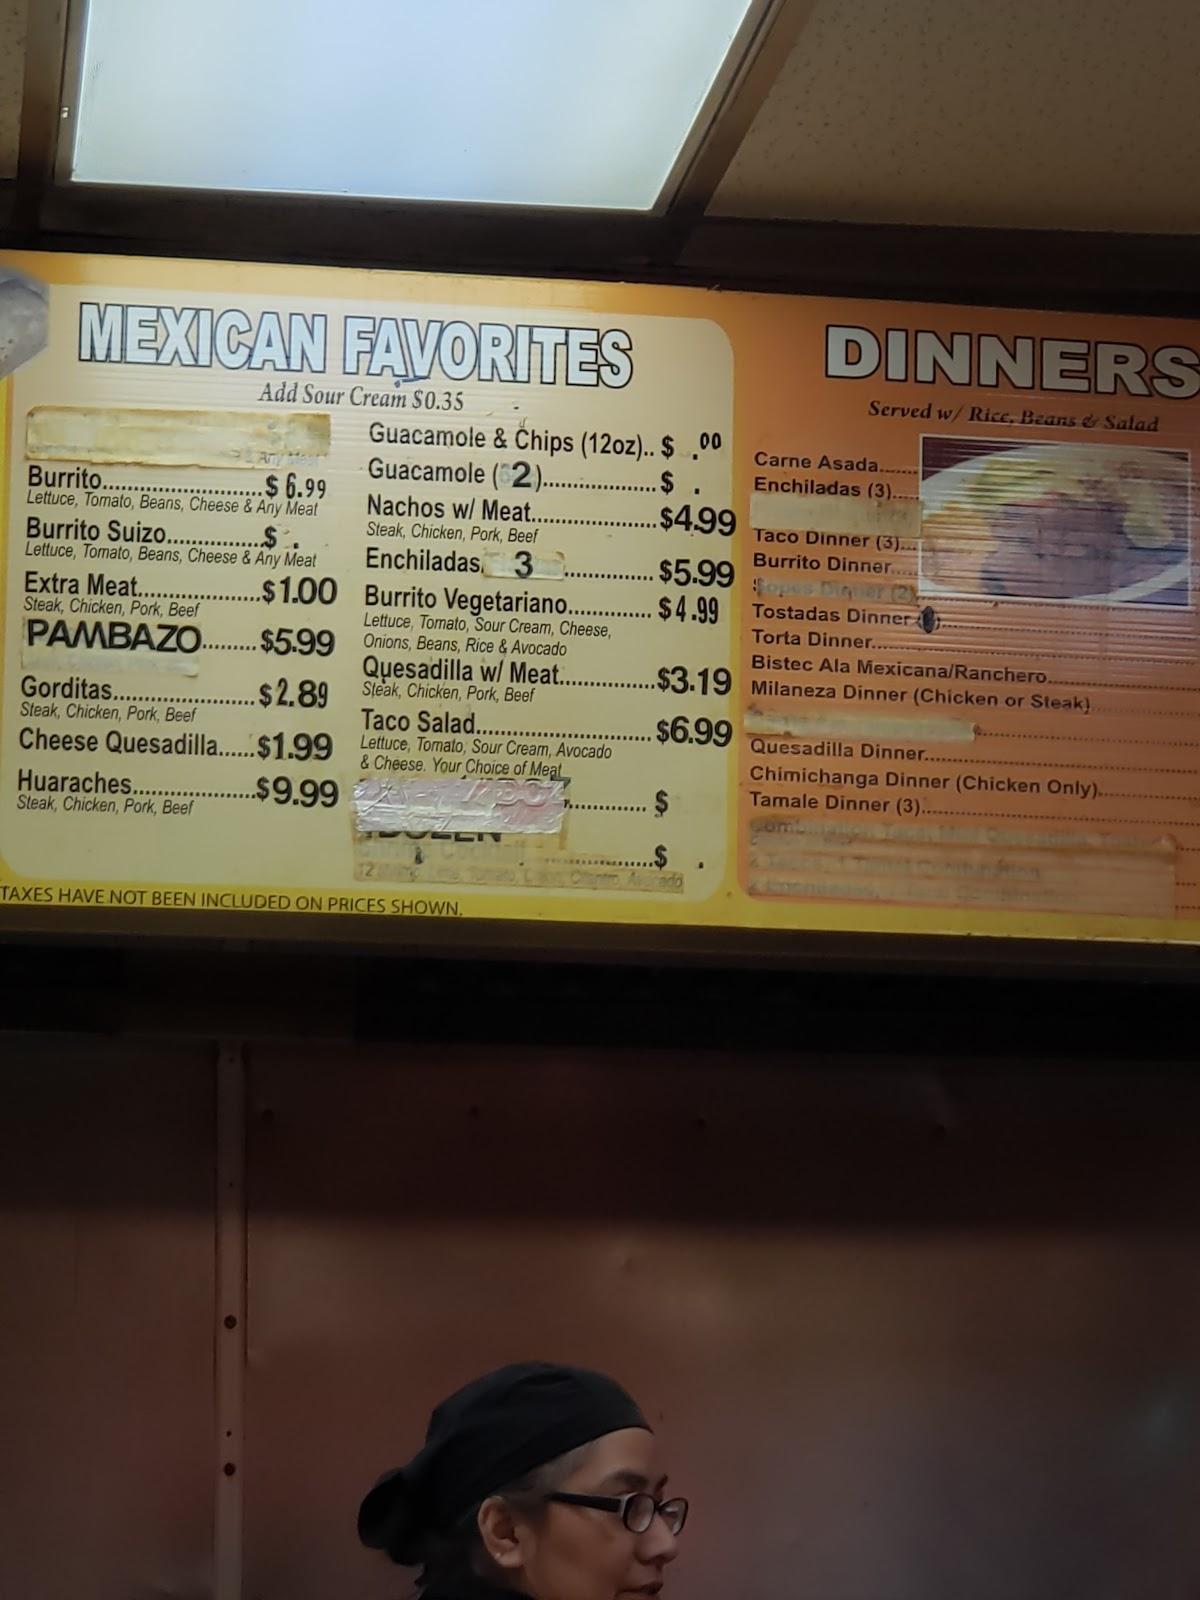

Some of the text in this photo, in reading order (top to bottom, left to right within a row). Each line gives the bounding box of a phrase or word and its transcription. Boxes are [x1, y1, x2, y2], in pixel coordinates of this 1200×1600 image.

[79, 302, 633, 388] MEXICAN FAVORITES
[825, 324, 1200, 399] DINNERS
[258, 382, 464, 411] Add Sour Cream $0.35
[869, 401, 933, 420] Served
[937, 405, 963, 422] w/
[1021, 409, 1076, 428] Beans
[1082, 413, 1099, 429] &
[1104, 413, 1160, 433] Salad
[369, 422, 486, 449] Guacamole
[495, 427, 508, 449] &
[515, 429, 574, 456] Chips
[581, 431, 644, 461] (12oz)
[368, 457, 486, 484] Guacamole
[754, 451, 879, 473] Carne Asada
[28, 465, 102, 489] Burrito
[754, 477, 892, 500] Enchiladas (3)
[27, 490, 318, 518] Lettuce, Tomato, Beans, Cheese & Any Meat
[367, 493, 737, 536] Nachos w/ Meat $4.99
[26, 516, 100, 541] Burrito
[107, 520, 166, 543] Suizo
[366, 522, 539, 544] Steak, Chicken, Pork, Beef
[754, 529, 901, 552] Taco Dinner (3)
[25, 542, 317, 570] Lettuce, Tomato, Beans, Cheese & Any Meat
[365, 547, 735, 588] Enchiladas 3 $5.99
[753, 553, 892, 575] Burrito Dinner
[24, 571, 338, 605] Extra Meat $1.00
[23, 596, 201, 617] Steak, Chicken, Pork, Beef
[364, 584, 719, 624] Burrito Vegetariano $4.99
[752, 604, 912, 625] Tostadas Dinner
[26, 619, 336, 657] PAMBAZO $5.99
[363, 612, 612, 640] Lettuce, Tomato, Sour Cream, Cheese,
[752, 630, 872, 649] Torta Dinner
[363, 633, 568, 657] Onions, Beans, Rice & Avocado
[362, 655, 732, 696] Quesadilla w/ Meat $3.19
[751, 655, 1047, 684] Bistec Ala Mexicana/Ranchero
[21, 675, 328, 708] Gorditas $2.89
[362, 681, 536, 704] Steak, Chicken, Pork, Beef
[751, 681, 1091, 714] Milaneza Dinner (Chicken or Steak)
[20, 702, 197, 723] Steak, Chicken, Pork, Beef
[361, 708, 733, 747] Taco Salad $6.99
[19, 727, 333, 762] Cheese Quesadilla $1.99
[360, 734, 612, 759] Lettuce, Tomato, Sour Cream, Avocado
[751, 739, 925, 762] Quesadilla Dinner
[360, 755, 370, 770] &
[433, 758, 461, 775] Your
[465, 759, 509, 776] Choice
[513, 760, 526, 777] of
[529, 762, 562, 778] Meat
[18, 769, 132, 795] Huaraches
[256, 776, 339, 808] $9.99
[750, 766, 1098, 799] Chimichanga Dinner (Chicken Only)
[17, 795, 195, 816] Steak, Chicken, Pork, Beef
[750, 791, 920, 816] Tamale Dinner (3)
[0, 885, 463, 917] TAXES HAVE NOT BEEN INCLUDED ON PRICES SHOWN.
